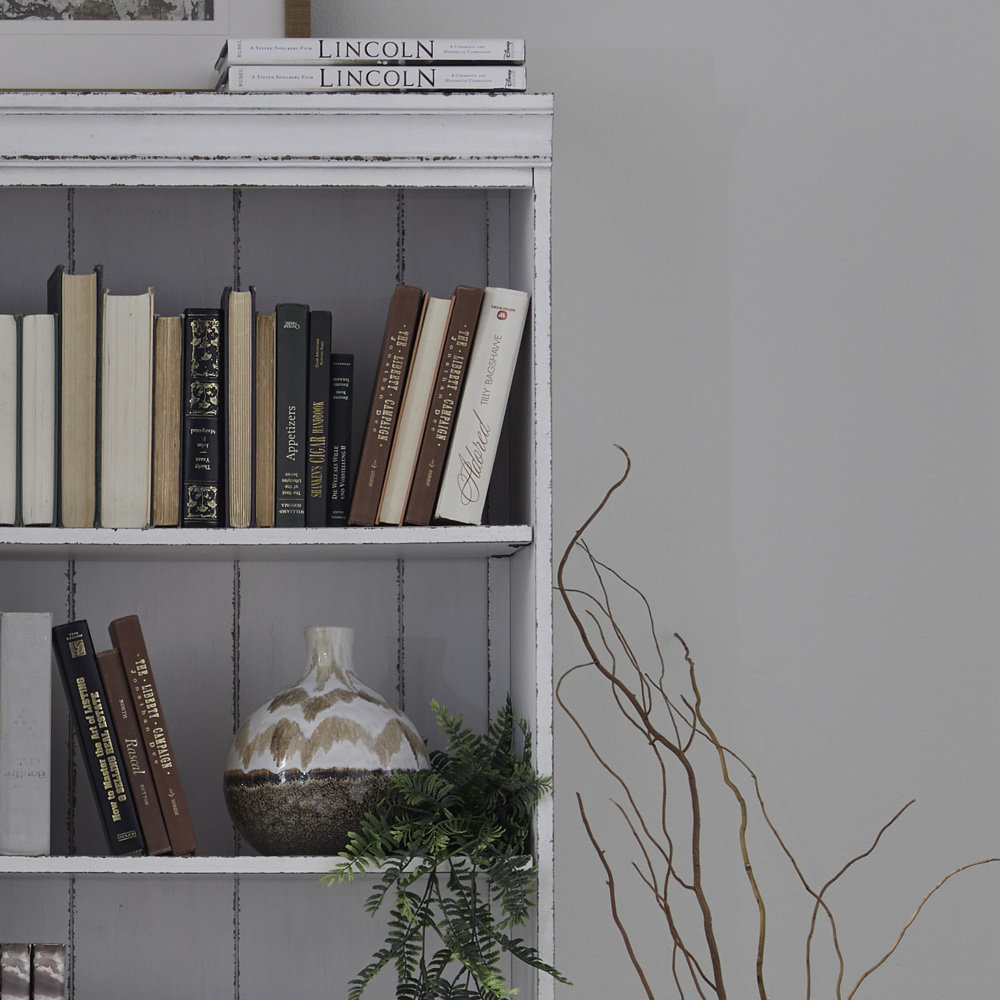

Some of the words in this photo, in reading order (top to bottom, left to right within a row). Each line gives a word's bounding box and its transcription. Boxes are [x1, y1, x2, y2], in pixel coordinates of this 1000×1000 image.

[318, 40, 435, 58] LINCOLN
[320, 68, 436, 88] LINCOLN
[395, 329, 409, 347] THE
[456, 329, 469, 347] THE
[386, 355, 404, 391] LIBERTY
[446, 355, 464, 391] LIBERTY
[483, 334, 503, 386] BAGSHAWE
[480, 387, 492, 406] TILLY
[285, 405, 297, 461] Appetizers
[311, 401, 324, 434] HANDBOOK
[376, 398, 393, 441] CAMPAIGN
[435, 398, 453, 441] CAMPAIGN
[309, 436, 326, 463] CIGAR
[457, 409, 491, 506] Adored
[310, 465, 323, 498] SHANKEN'S
[75, 677, 92, 714] LISTING
[90, 691, 108, 728] ESTATE
[85, 715, 96, 724] of
[134, 658, 148, 676] THE
[141, 684, 160, 720] LIBERTY
[152, 727, 173, 769] CAMPAIGN
[88, 725, 101, 740] Art
[93, 741, 106, 757] the
[101, 729, 115, 755] REAL
[118, 699, 128, 719] NORTH
[124, 738, 146, 776] Rascal
[98, 759, 114, 790] Master
[109, 755, 126, 793] SELLING
[107, 791, 117, 800] to
[109, 801, 122, 822] How
